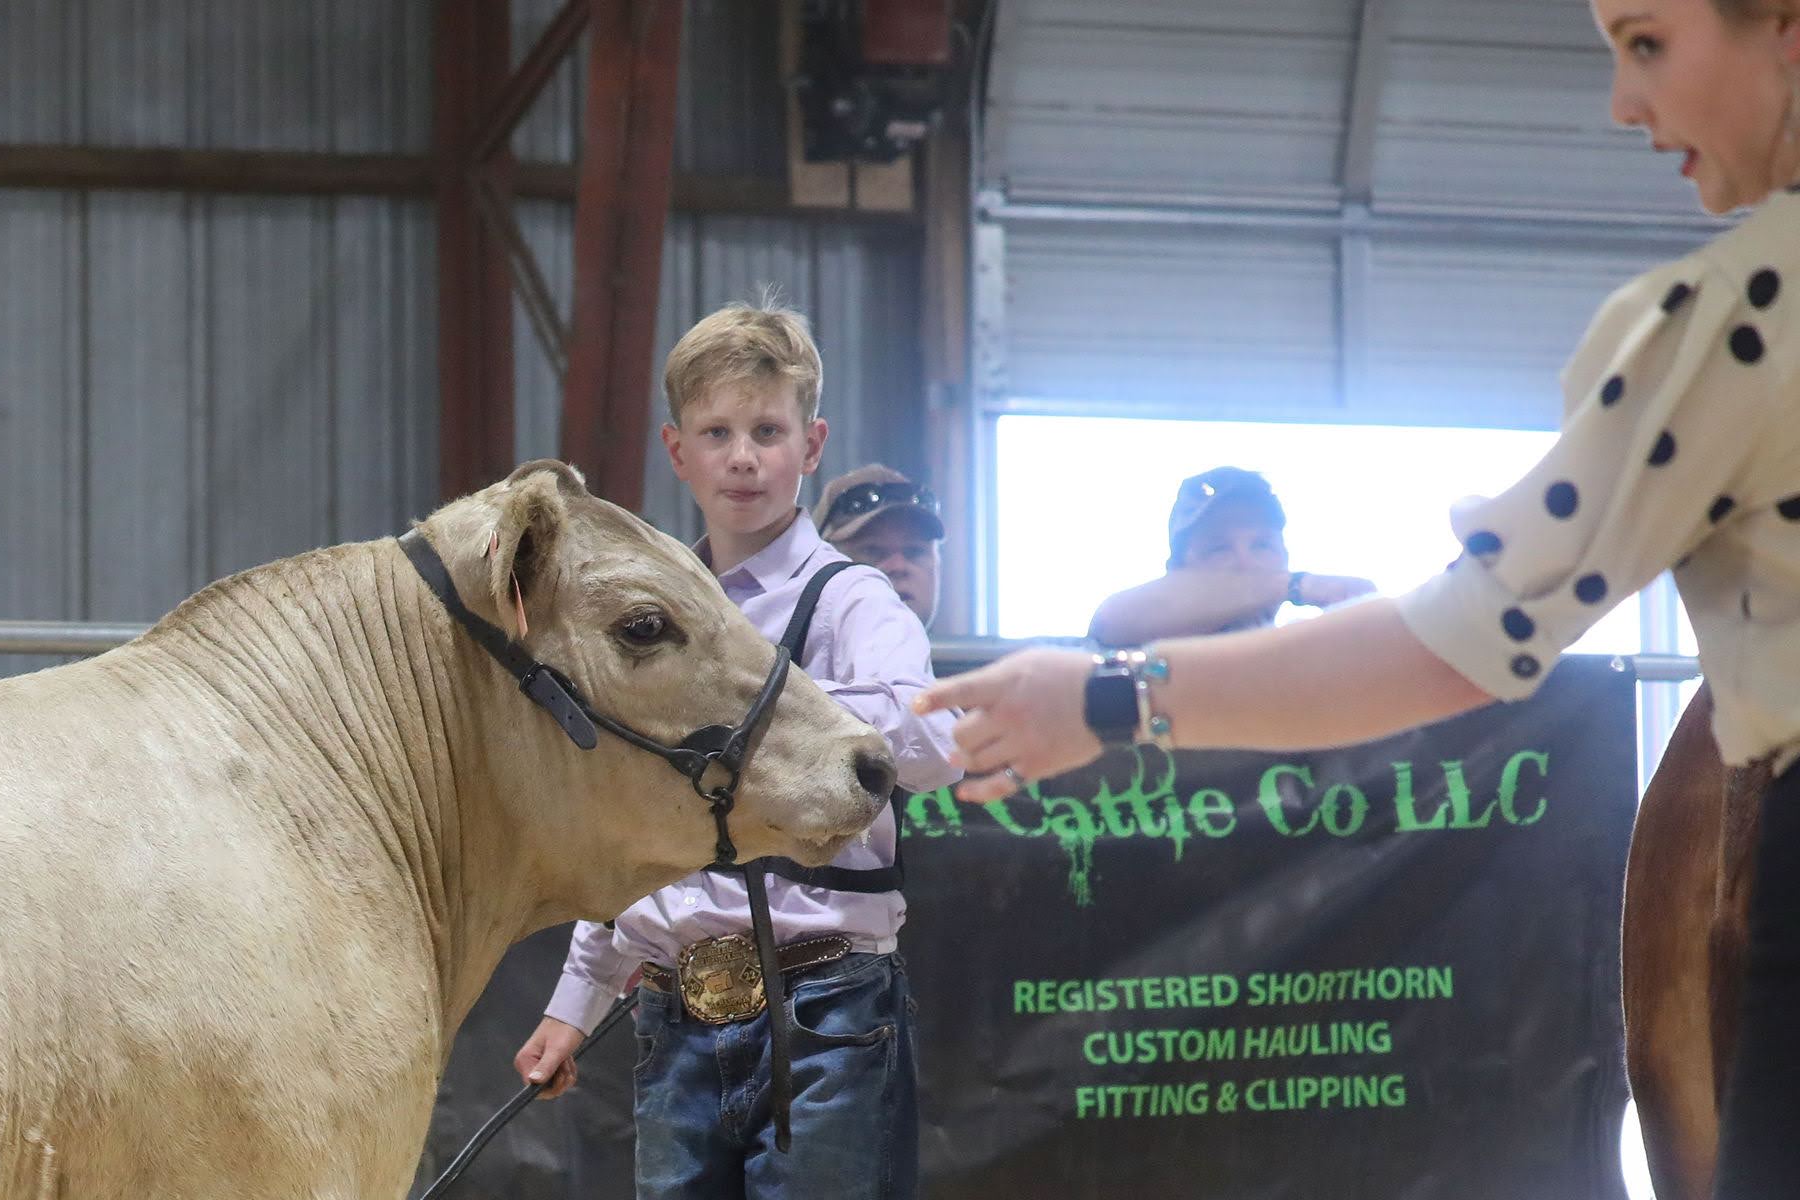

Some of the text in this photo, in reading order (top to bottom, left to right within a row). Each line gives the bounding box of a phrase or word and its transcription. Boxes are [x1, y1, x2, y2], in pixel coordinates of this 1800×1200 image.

[1257, 764, 1370, 837] Co
[1390, 750, 1549, 833] LLC
[1013, 966, 1455, 1014] REGISTERED SHORTHORN
[1082, 1020, 1393, 1065] CUSTOM HAULING
[1075, 1073, 1407, 1119] FITTING & CLIPPING
